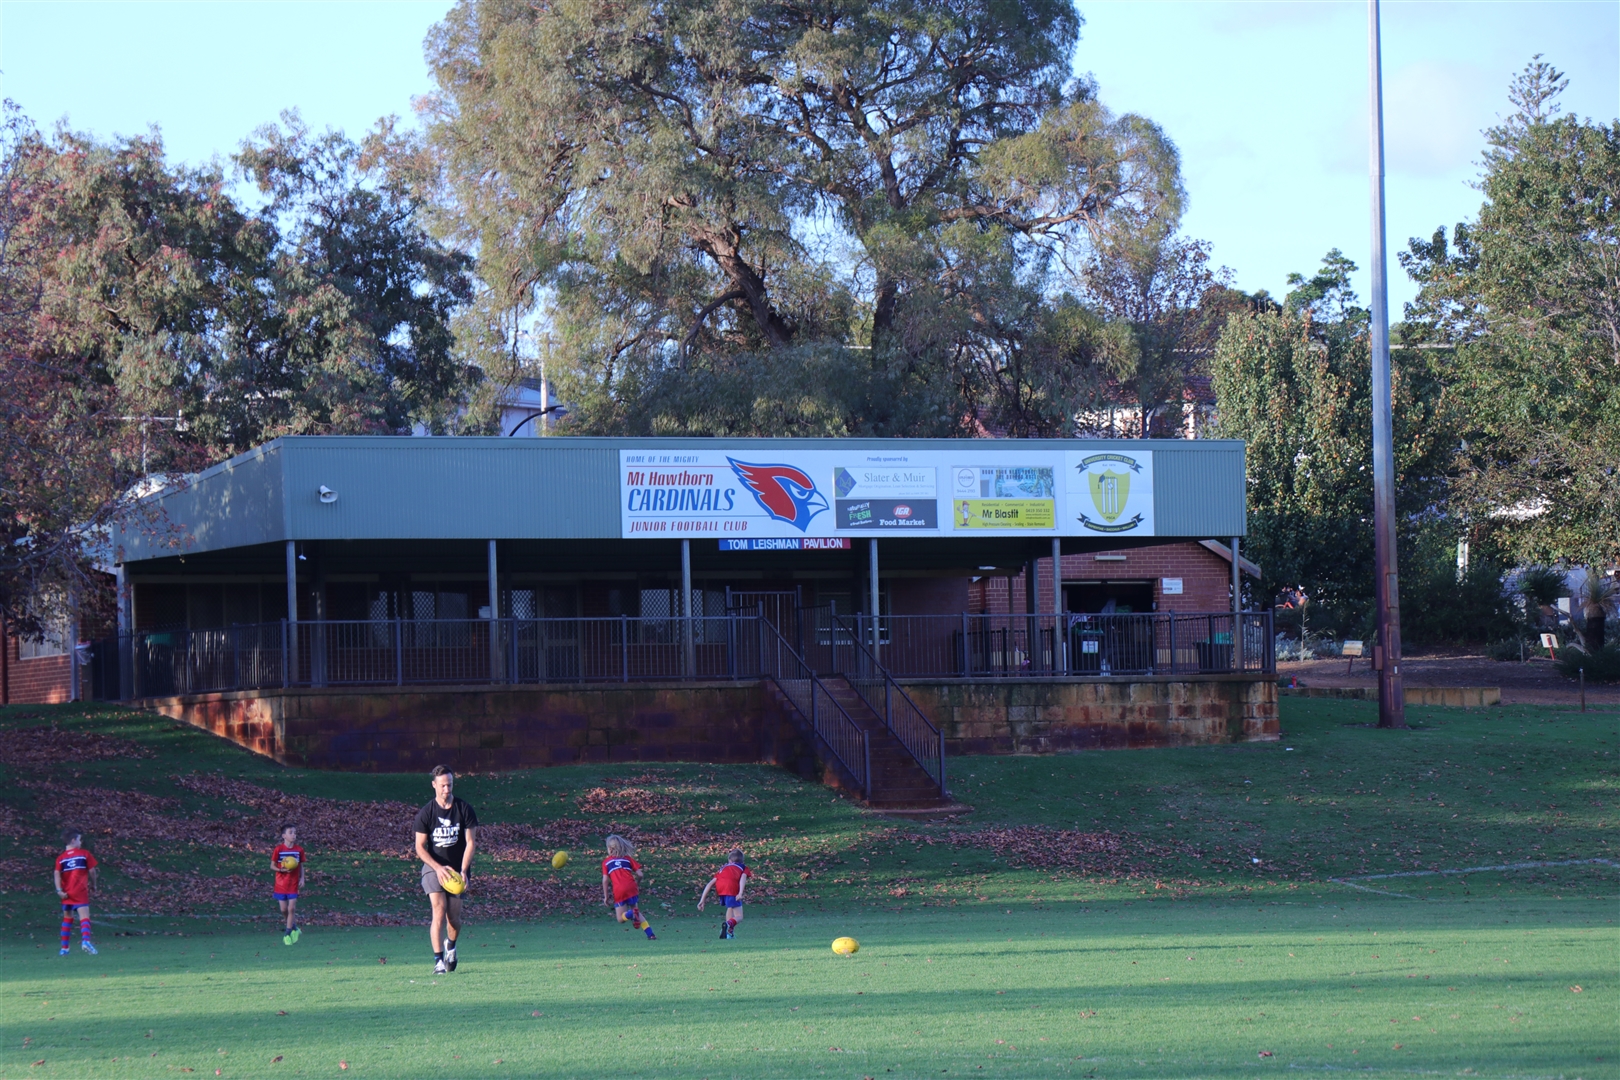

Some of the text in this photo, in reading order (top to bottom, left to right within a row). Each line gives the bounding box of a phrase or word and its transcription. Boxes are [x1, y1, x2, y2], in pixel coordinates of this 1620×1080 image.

[1123, 457, 1135, 465] CLUB
[627, 471, 714, 486] Mt Hawthorn
[864, 472, 926, 482] Slater & Muir
[628, 488, 735, 512] CARDINALS
[894, 507, 910, 516] IGA
[982, 509, 1019, 518] Mr Blastit
[629, 520, 748, 533] JUNIOR FOOTBALL CLUB
[728, 538, 843, 550] TOM LEISHMAN PAVILION
